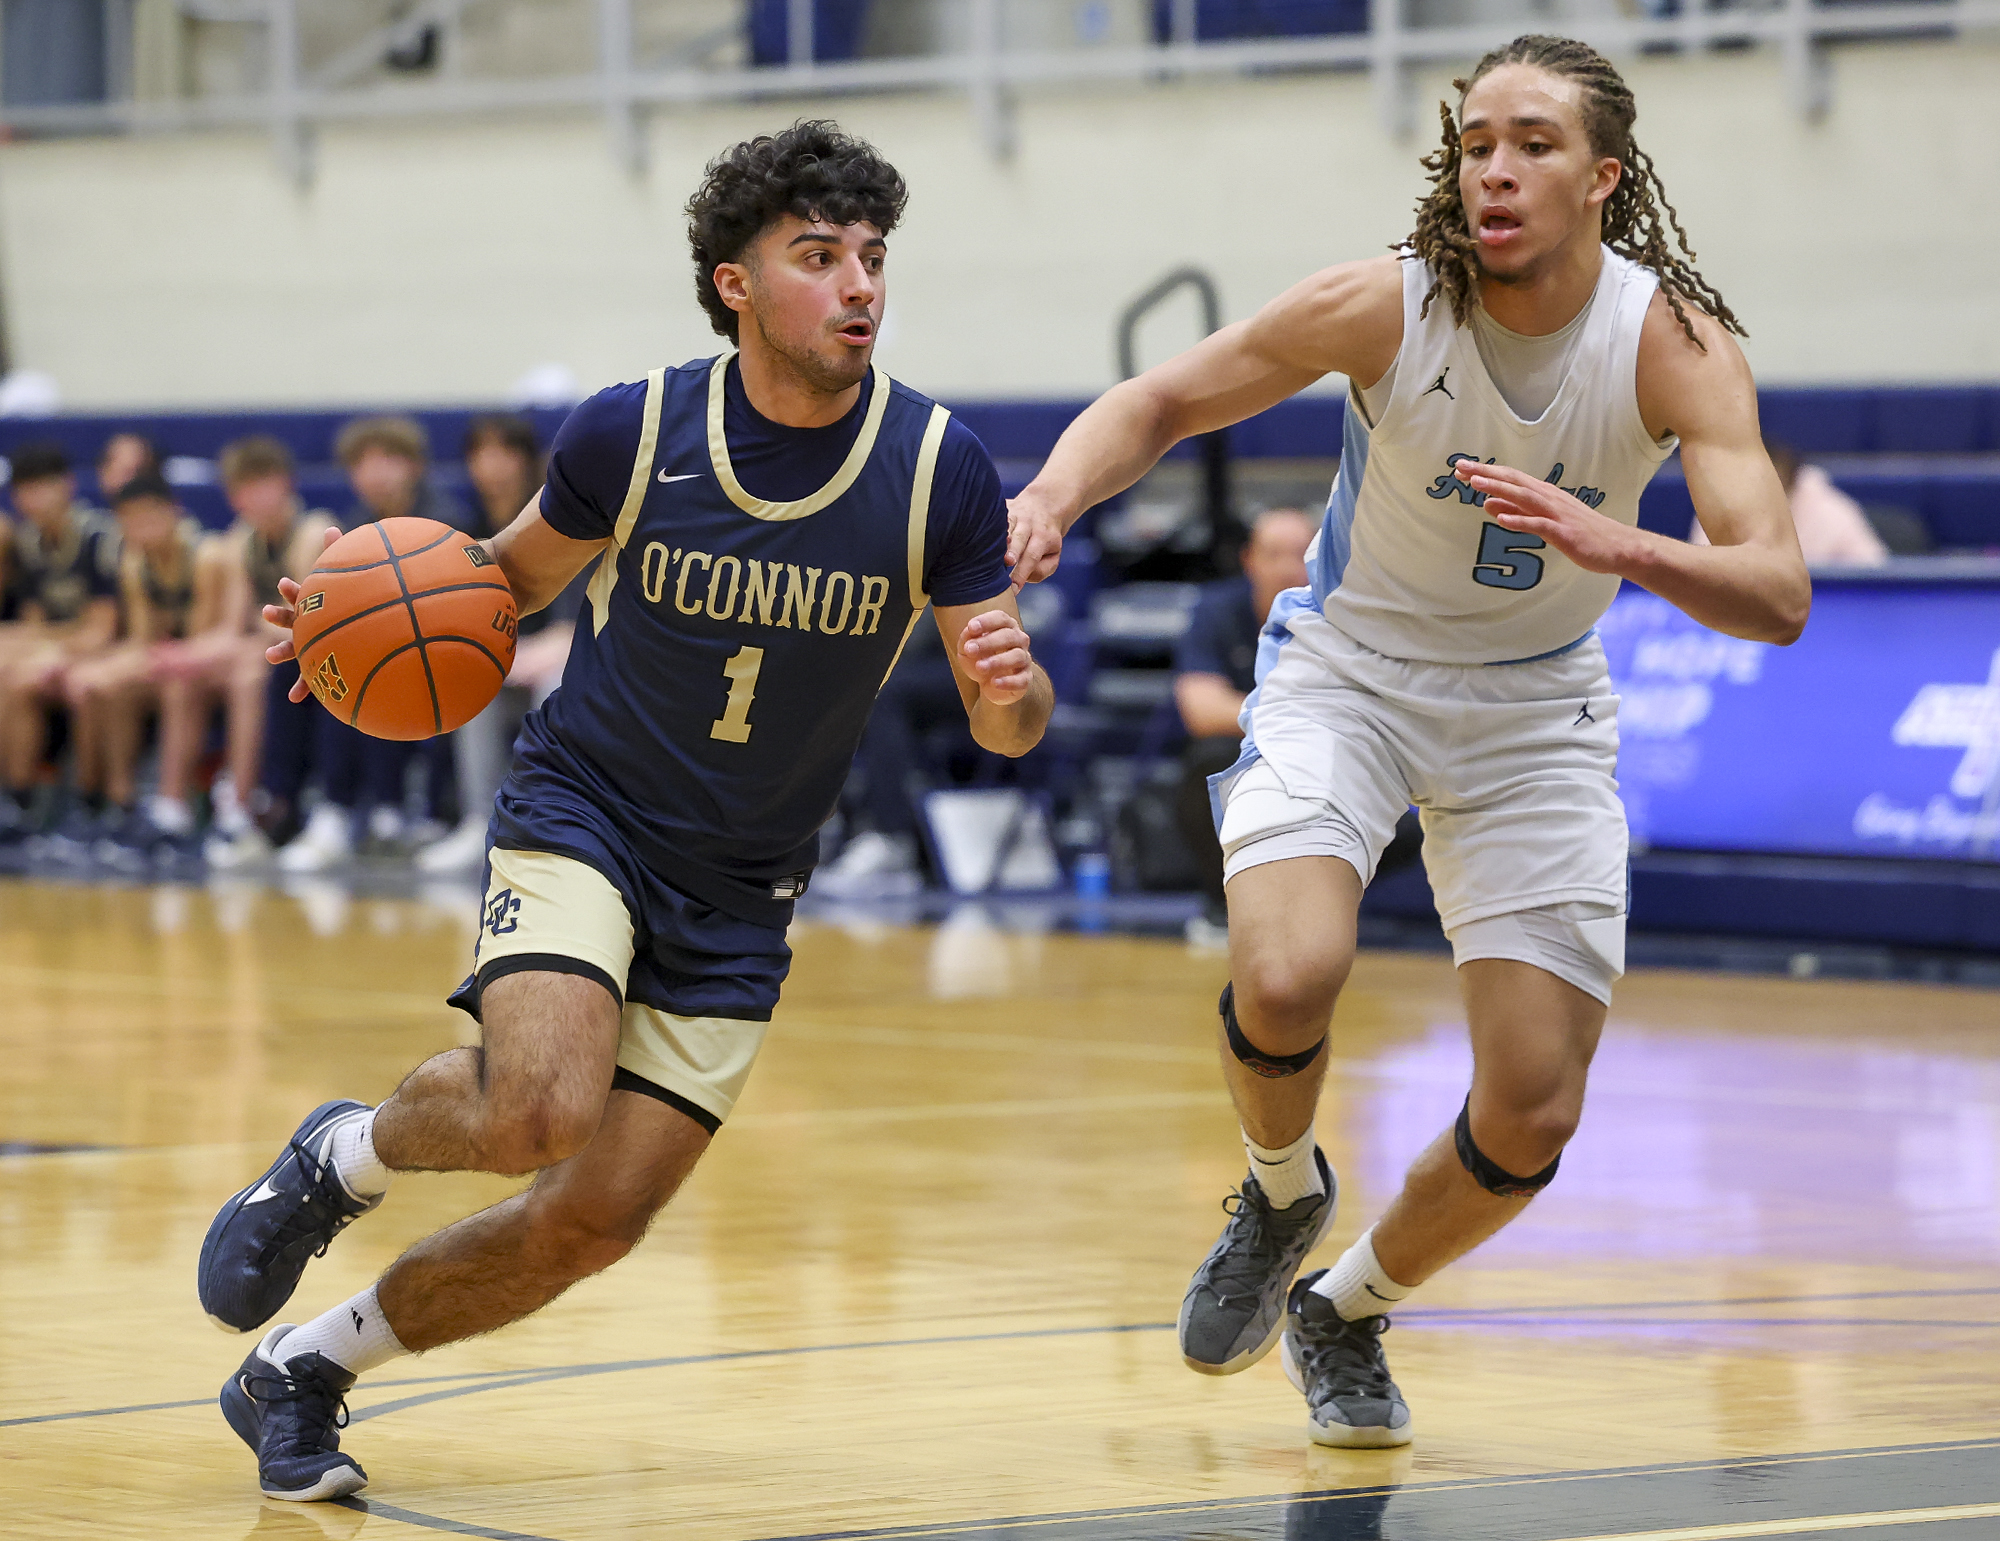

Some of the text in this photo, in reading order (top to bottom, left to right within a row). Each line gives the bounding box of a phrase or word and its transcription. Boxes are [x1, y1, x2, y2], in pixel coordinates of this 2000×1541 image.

[641, 541, 889, 636] O'CONNOR
[1472, 521, 1546, 591] 5
[710, 645, 764, 743] 1
